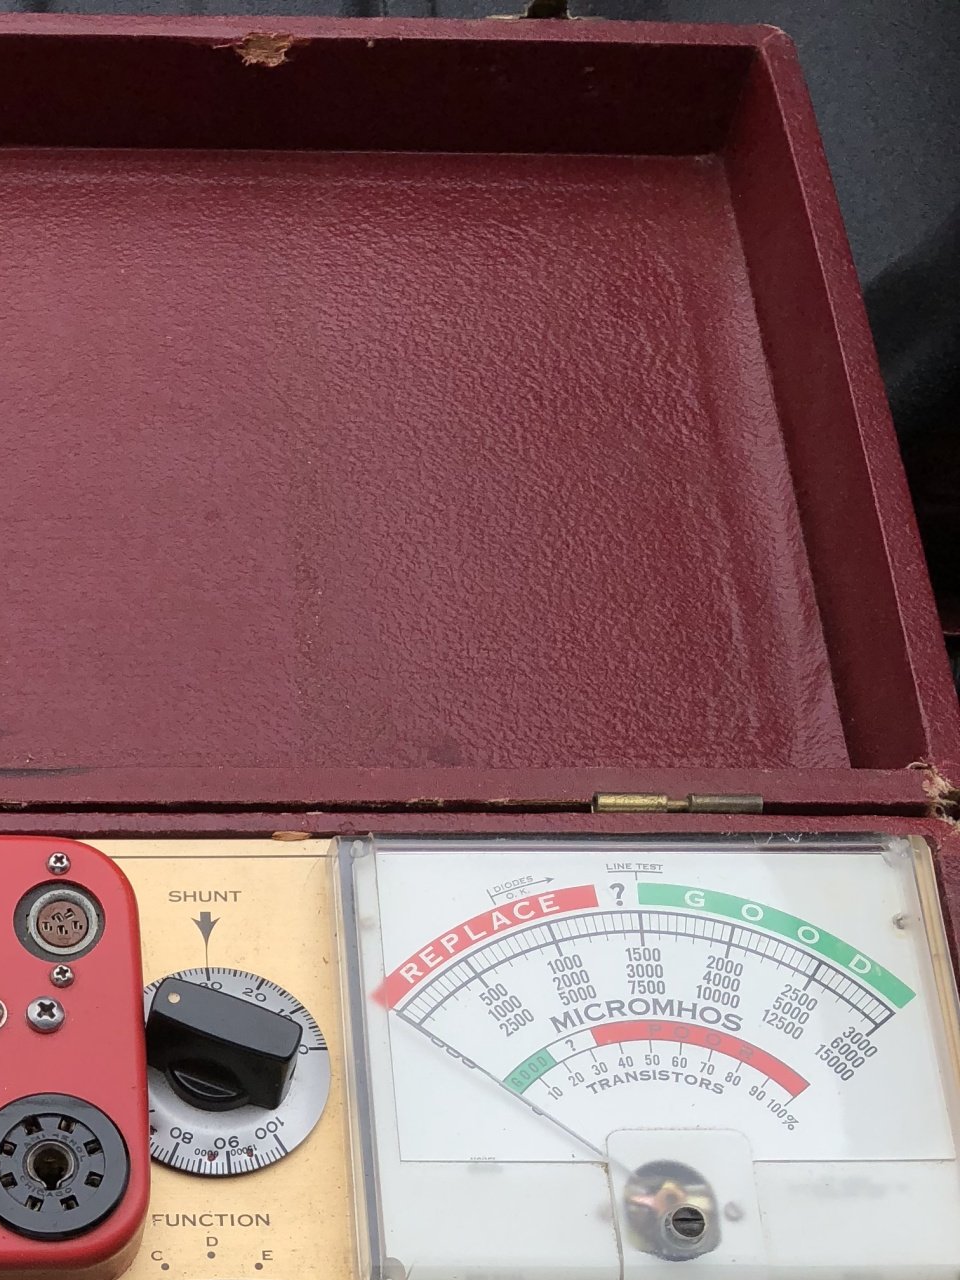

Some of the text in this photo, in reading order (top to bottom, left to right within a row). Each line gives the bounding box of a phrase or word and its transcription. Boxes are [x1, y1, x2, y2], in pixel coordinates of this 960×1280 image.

[636, 863, 664, 871] TEST
[168, 890, 242, 902] SHUNT
[493, 875, 534, 893] DIODES
[609, 883, 625, 906] ?
[399, 893, 560, 984] REPLACE
[684, 890, 872, 974] GOOD
[547, 954, 583, 975] 1000
[625, 947, 661, 962] 1500
[705, 955, 744, 977] 2000
[552, 969, 590, 991] 2000
[626, 964, 664, 979] 3000
[702, 970, 741, 992] 4000
[242, 987, 268, 1003] 20
[478, 982, 508, 1007] 500
[558, 984, 597, 1006] 5000
[628, 980, 666, 995] 7500
[696, 984, 741, 1009] 10000
[784, 984, 818, 1012] 2500
[488, 994, 522, 1022] 1000
[548, 997, 744, 1034] MICROMHOS
[772, 996, 810, 1025] 5000
[498, 1008, 535, 1037] 2500
[761, 1008, 804, 1040] 12500
[830, 1036, 866, 1070] 6000
[842, 1026, 878, 1058] 3000
[510, 1056, 550, 1089] GOOD
[814, 1044, 855, 1082] 15000
[547, 1054, 800, 1132] 10 20 30 40 50 60 70 80 90 100%
[586, 1069, 724, 1096] TRANSISTORS
[254, 1116, 285, 1140] 100
[152, 1213, 271, 1227] FUNCTION
